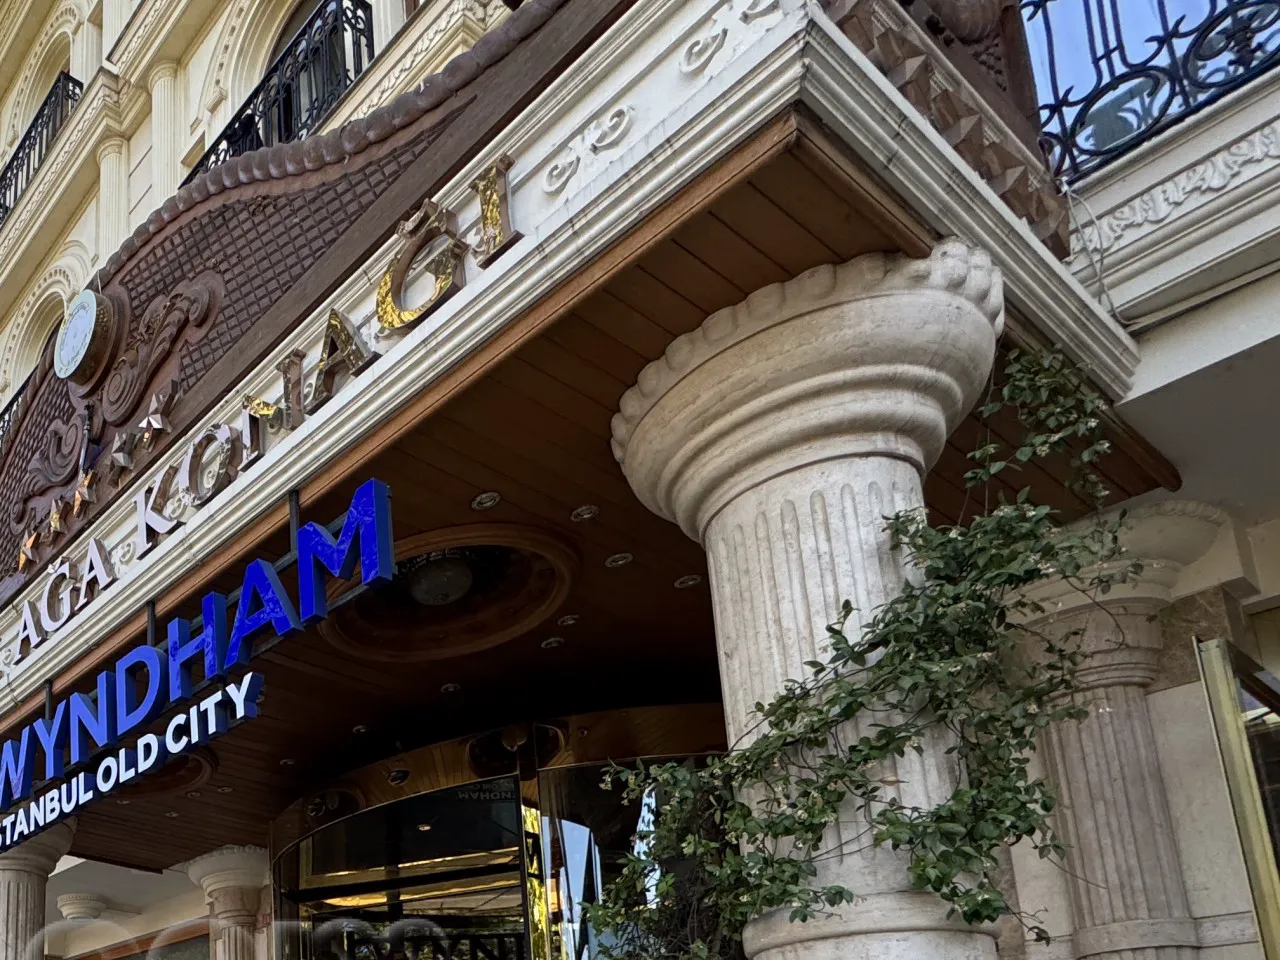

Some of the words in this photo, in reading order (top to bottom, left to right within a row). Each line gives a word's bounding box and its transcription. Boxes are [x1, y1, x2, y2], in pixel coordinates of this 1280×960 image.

[11, 538, 115, 665] AĞA
[135, 154, 524, 560] KONAĞI
[96, 733, 159, 794] OLD
[165, 671, 258, 755] CITY
